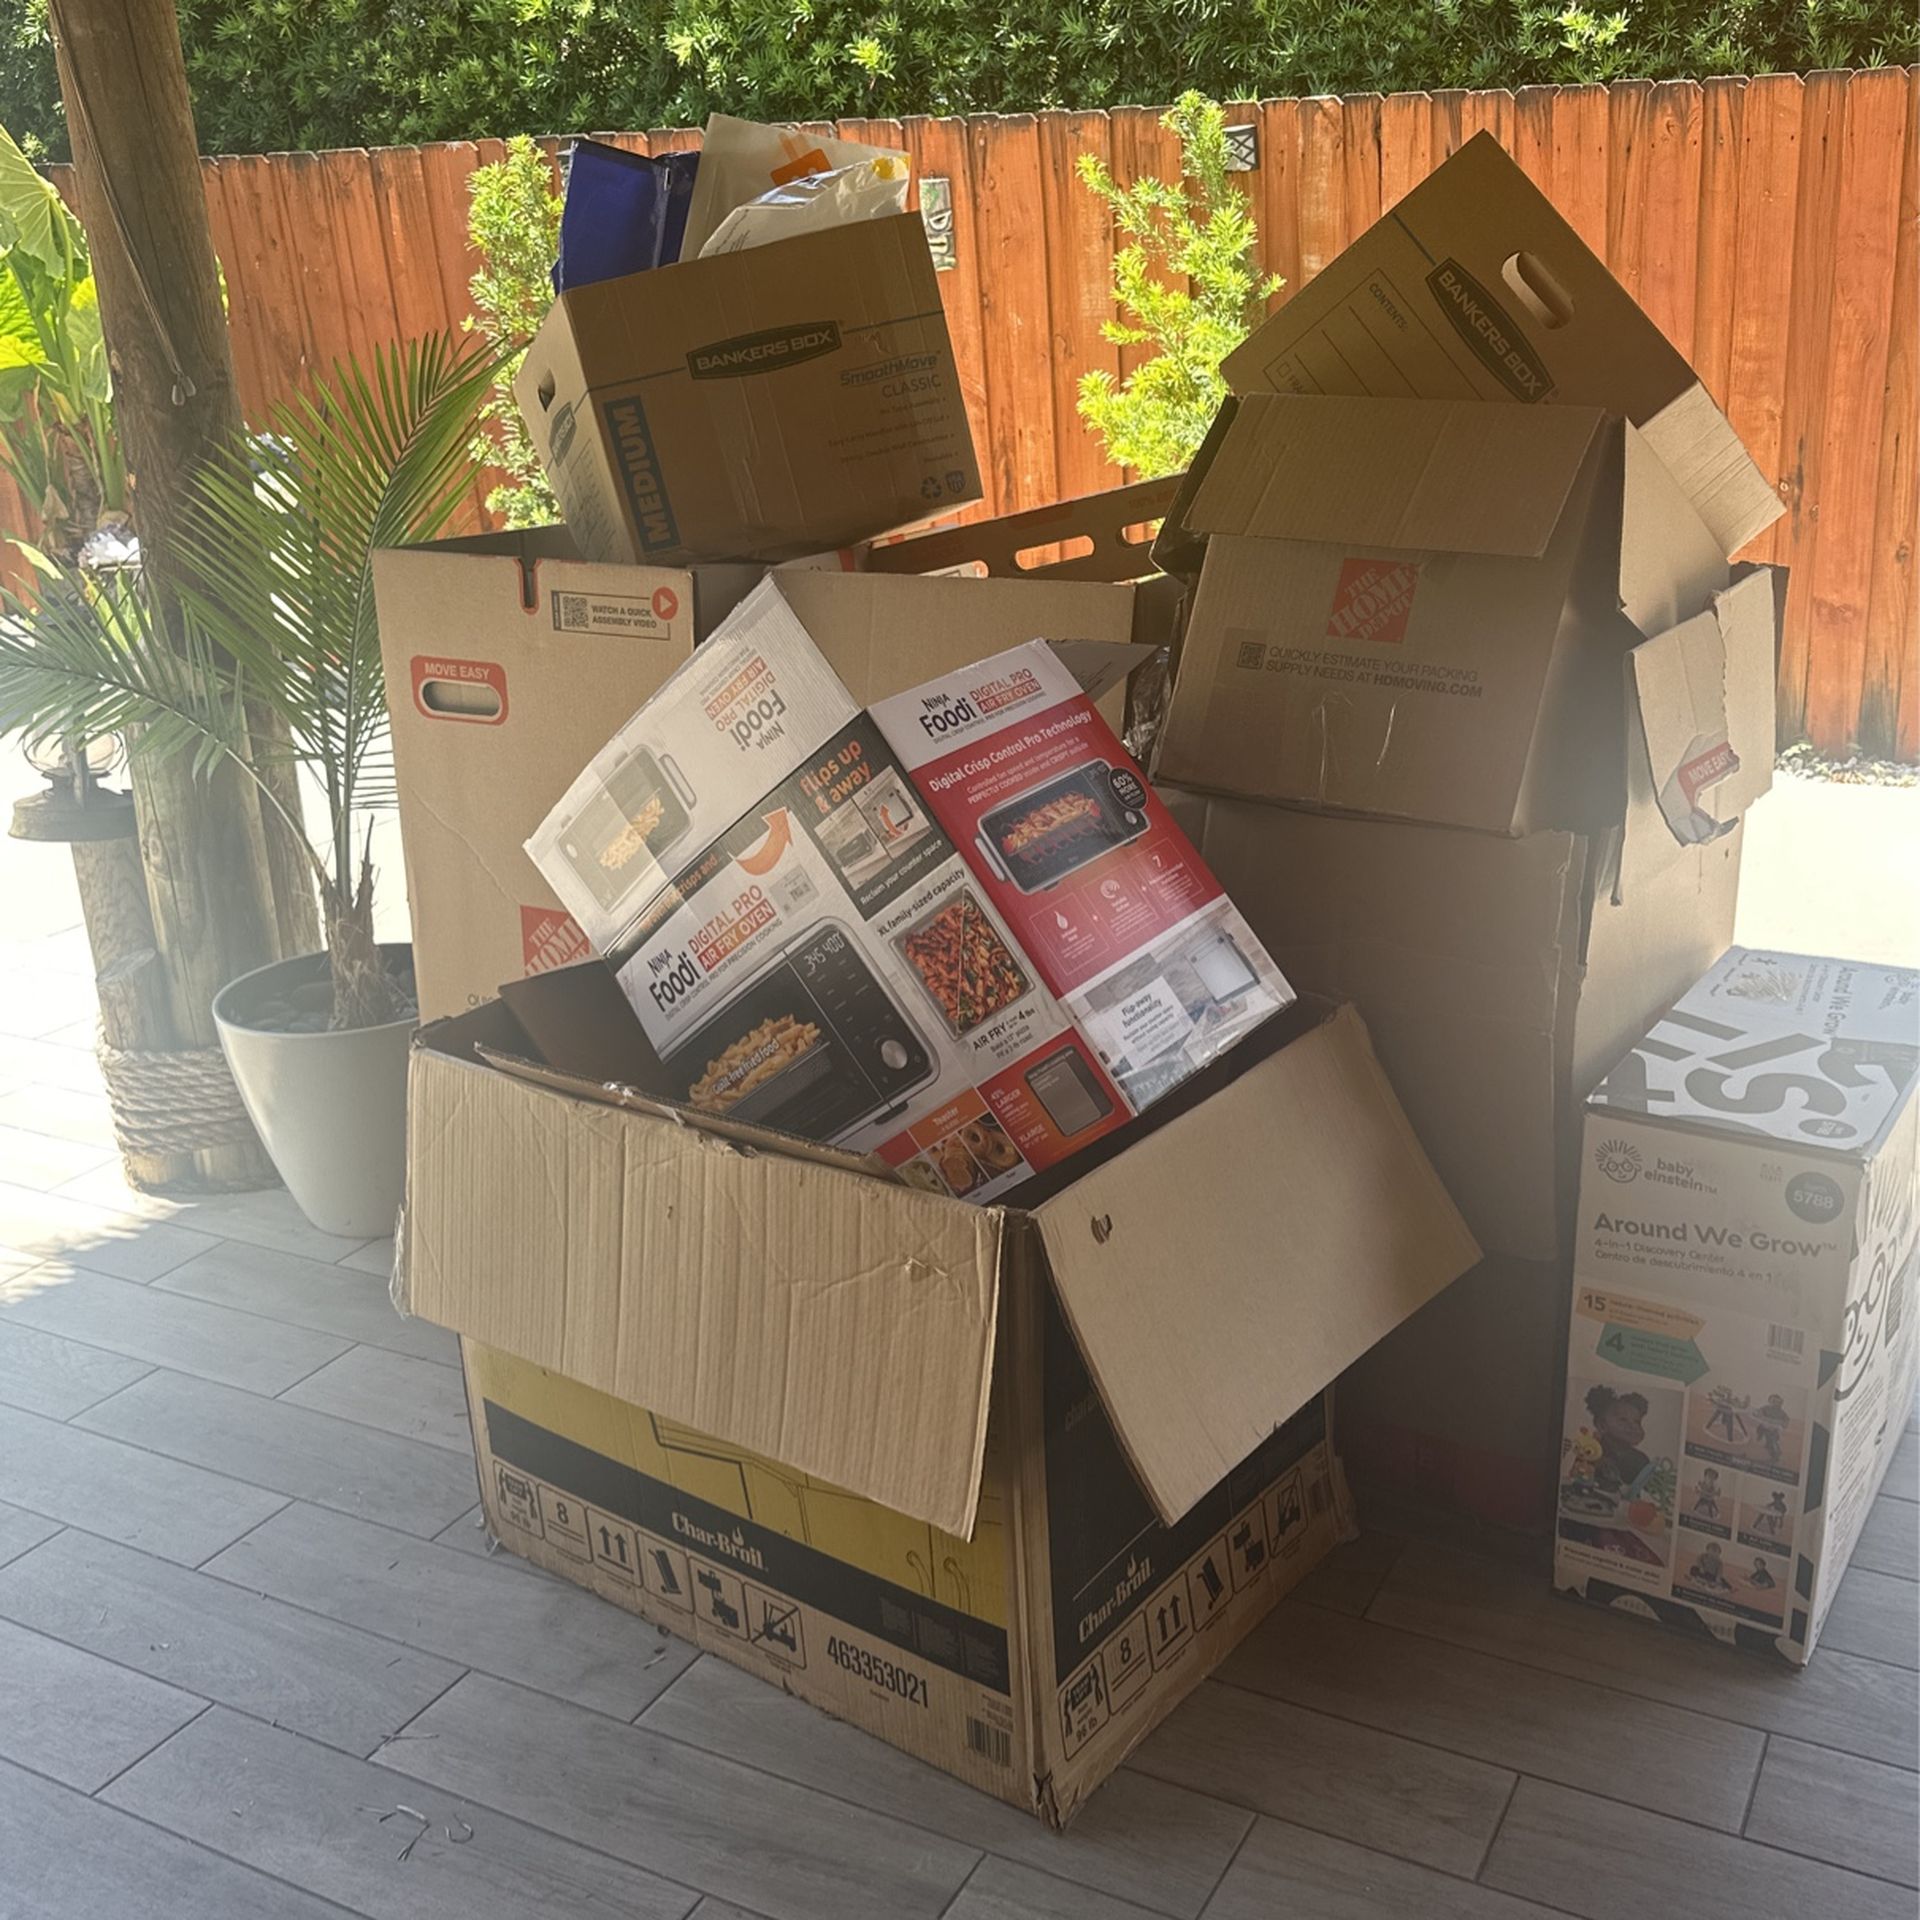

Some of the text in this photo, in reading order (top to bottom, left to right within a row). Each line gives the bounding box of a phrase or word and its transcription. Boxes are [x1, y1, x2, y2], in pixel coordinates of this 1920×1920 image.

[1437, 269, 1543, 394] BANKERS BOX
[697, 329, 833, 371] BANKERS BOX
[881, 374, 941, 398] CLASSIC
[612, 404, 672, 544] MEDIUM
[1343, 567, 1379, 598] THE
[591, 604, 652, 619] WATCH A QUICK
[591, 615, 657, 629] ASSEMBLY VIDEO
[424, 662, 490, 680] MOVE EASY
[1266, 660, 1482, 697] SUPPLY NEEDS AT HDMOVING.COM
[1269, 646, 1478, 682] QUICKLY ESTIMATE YOUR PACKING
[706, 660, 766, 718] AIR FRY OVEN
[736, 671, 776, 711] DIGITAL
[969, 668, 1033, 701] DIGITAL PRO
[980, 678, 1041, 713] AIR FRY OVEN
[919, 697, 976, 737] Foodi
[921, 693, 950, 712] NINJA
[715, 709, 738, 732] PRO
[730, 689, 787, 751] Foodi
[756, 721, 785, 750] NINJA
[929, 709, 1093, 793] Digital Crisp Control Pro Technology
[801, 740, 863, 797] flips up
[829, 761, 872, 802] away
[1688, 760, 1715, 784] MOVE
[678, 856, 719, 894] crisps and
[884, 872, 900, 890] your
[899, 854, 923, 876] counter
[922, 839, 943, 860] space
[1152, 856, 1162, 868] 7
[688, 911, 735, 954] DIGITAL
[731, 885, 762, 916] PRO
[876, 868, 965, 938] XL family-sized capacity
[528, 917, 555, 947] THE
[700, 904, 774, 970] AIR FRY OVEN
[727, 938, 758, 969] PRECISION
[755, 918, 783, 944] COOKING
[647, 949, 673, 978] NINJA
[649, 951, 700, 1012] Foodi
[1019, 1010, 1026, 1020] 4
[1823, 1010, 1847, 1037] Grow
[973, 1034, 990, 1051] AIR
[987, 1022, 1007, 1040] FRY
[743, 1051, 763, 1074] fried
[761, 1038, 781, 1061] food
[996, 1087, 1023, 1111] LARGER
[1656, 1157, 1694, 1178] baby
[1594, 1212, 1688, 1242] Around
[1694, 1223, 1743, 1248] We
[1594, 1238, 1725, 1264] 4-in-1 Discovery Center
[1595, 1250, 1630, 1264] Centro
[1632, 1253, 1647, 1265] de
[1649, 1256, 1735, 1278] descubrimiento
[1748, 1270, 1763, 1281] en
[1584, 1294, 1607, 1313] 15
[1605, 1332, 1625, 1352] 4
[556, 1501, 570, 1525] 8
[1120, 1637, 1133, 1665] 8
[827, 1634, 930, 1709] 463353021
